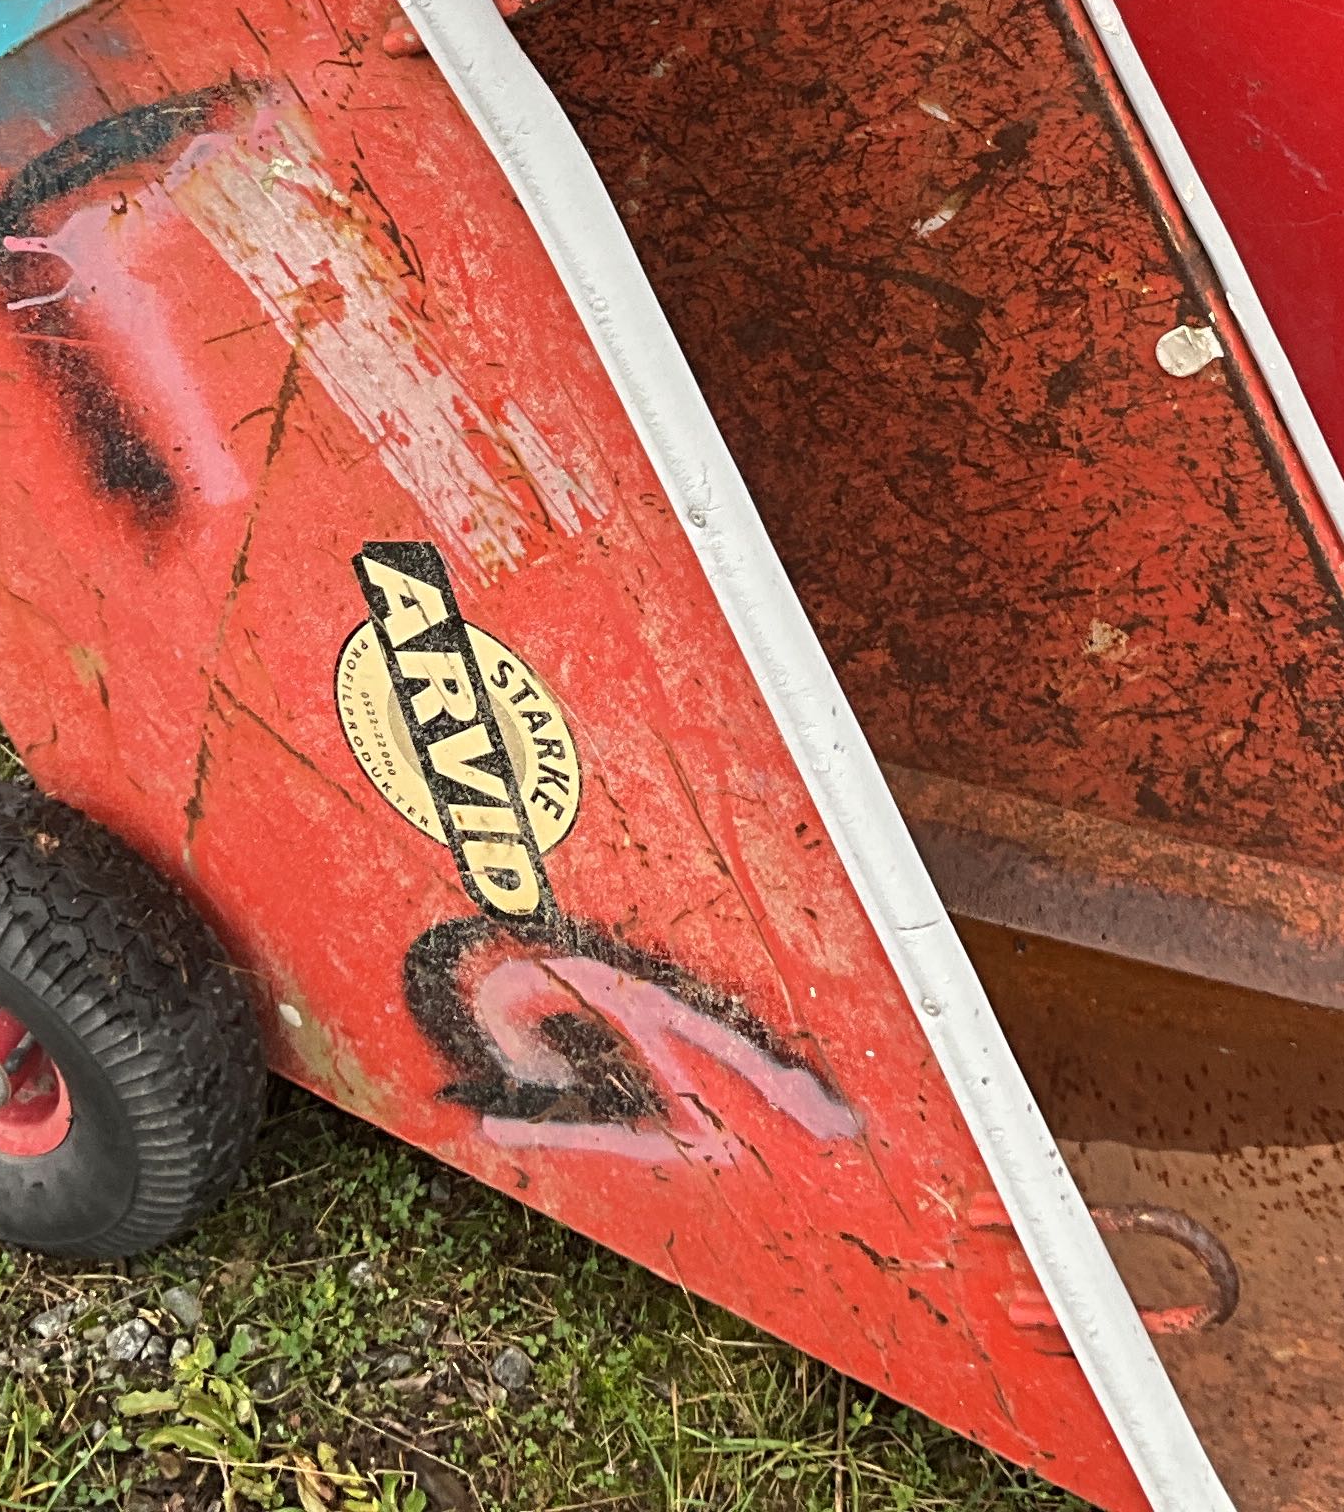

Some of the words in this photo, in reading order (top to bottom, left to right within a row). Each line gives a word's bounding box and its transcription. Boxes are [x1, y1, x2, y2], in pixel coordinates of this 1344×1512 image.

[342, 638, 430, 828] PROFILPRODUKTER
[361, 556, 541, 915] ARVID
[490, 659, 571, 821] STARKE
